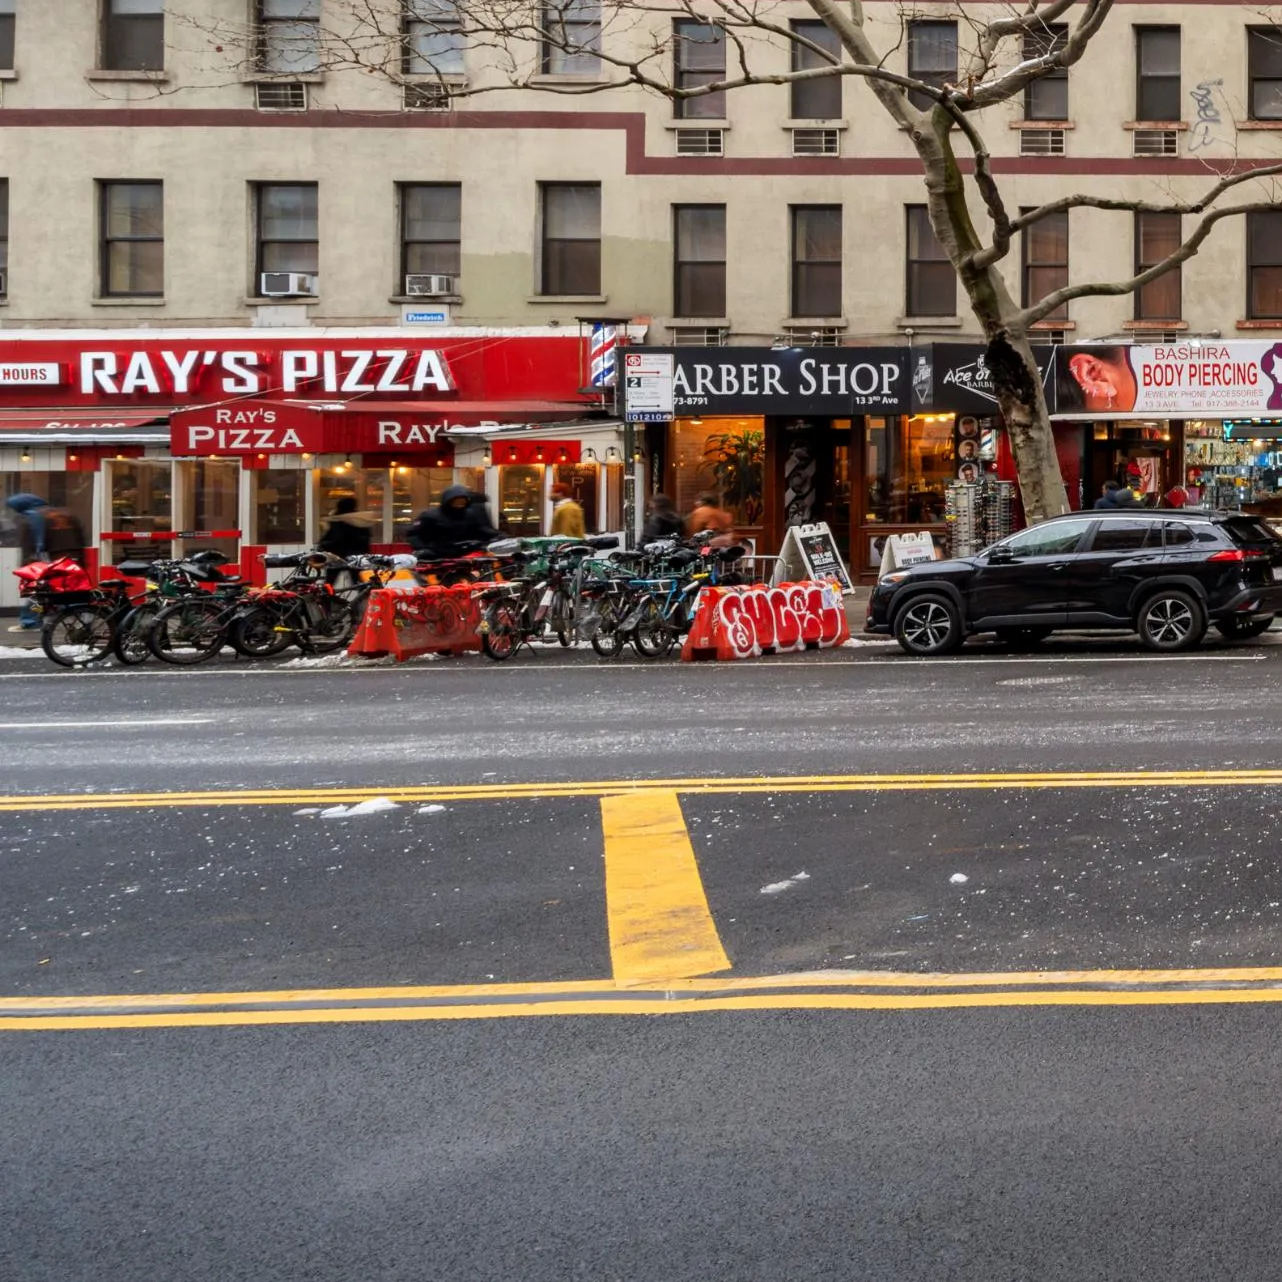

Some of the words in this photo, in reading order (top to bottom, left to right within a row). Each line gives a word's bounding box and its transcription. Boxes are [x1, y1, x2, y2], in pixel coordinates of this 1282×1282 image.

[1154, 347, 1230, 360] BASHIRA
[2, 368, 47, 381] HOURS
[81, 350, 260, 394] RAY'S
[282, 350, 450, 392] PIZZA
[673, 364, 789, 395] ARBER
[799, 358, 900, 396] SHOP
[943, 369, 972, 384] Ace
[1143, 364, 1184, 387] BODY
[1188, 363, 1258, 386] PIERCING
[629, 378, 639, 388] 2
[855, 397, 866, 405] 13
[882, 397, 898, 405] Ave
[217, 408, 276, 424] RAY'S
[188, 426, 304, 450] PIZZA
